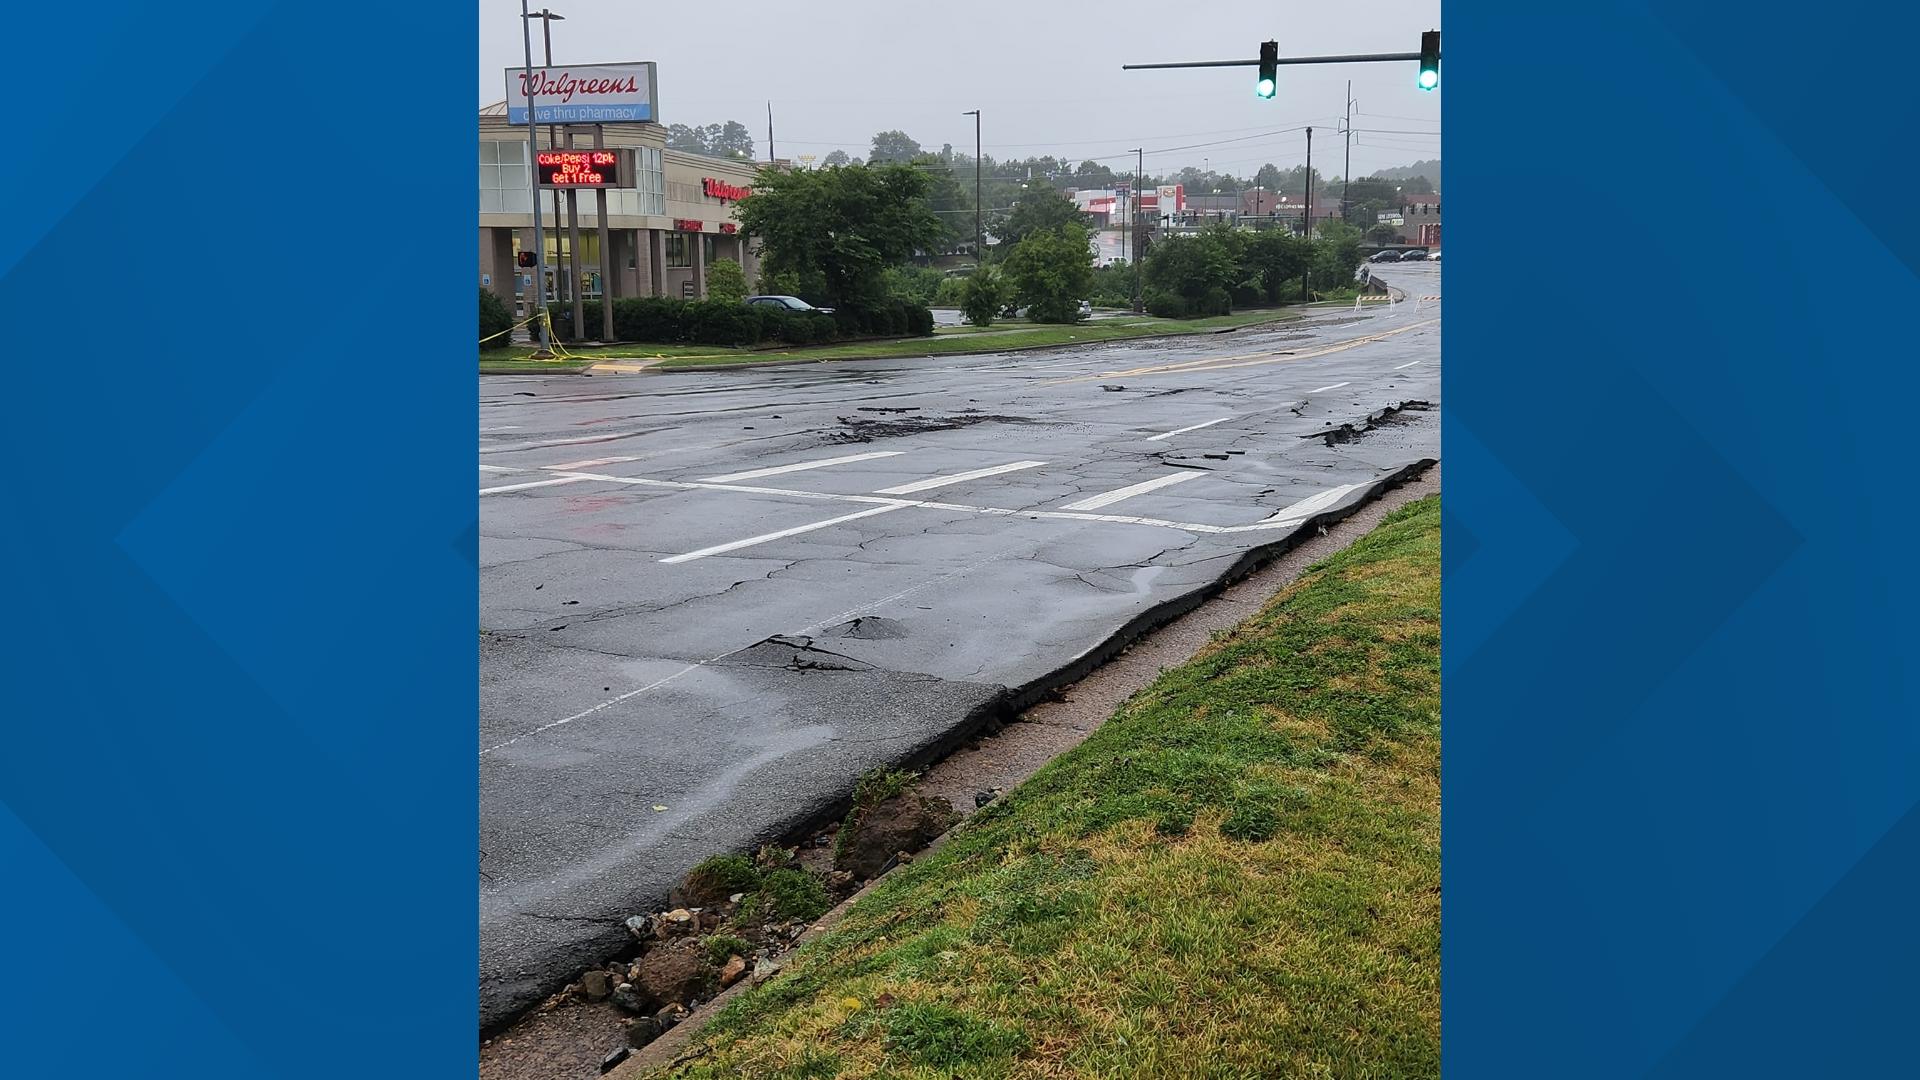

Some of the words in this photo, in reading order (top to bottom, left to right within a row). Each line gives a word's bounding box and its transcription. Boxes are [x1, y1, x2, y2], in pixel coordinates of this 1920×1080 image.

[518, 70, 640, 103] Walgreens
[523, 107, 551, 121] dive
[554, 106, 576, 119] thru
[579, 106, 637, 121] pharmacy
[538, 153, 590, 164] Coke/Pepsi
[593, 152, 615, 164] 12pk
[562, 163, 580, 174] Buy
[584, 163, 591, 173] 2
[552, 173, 569, 183] Get
[571, 173, 577, 183] 1
[579, 173, 602, 183] Free
